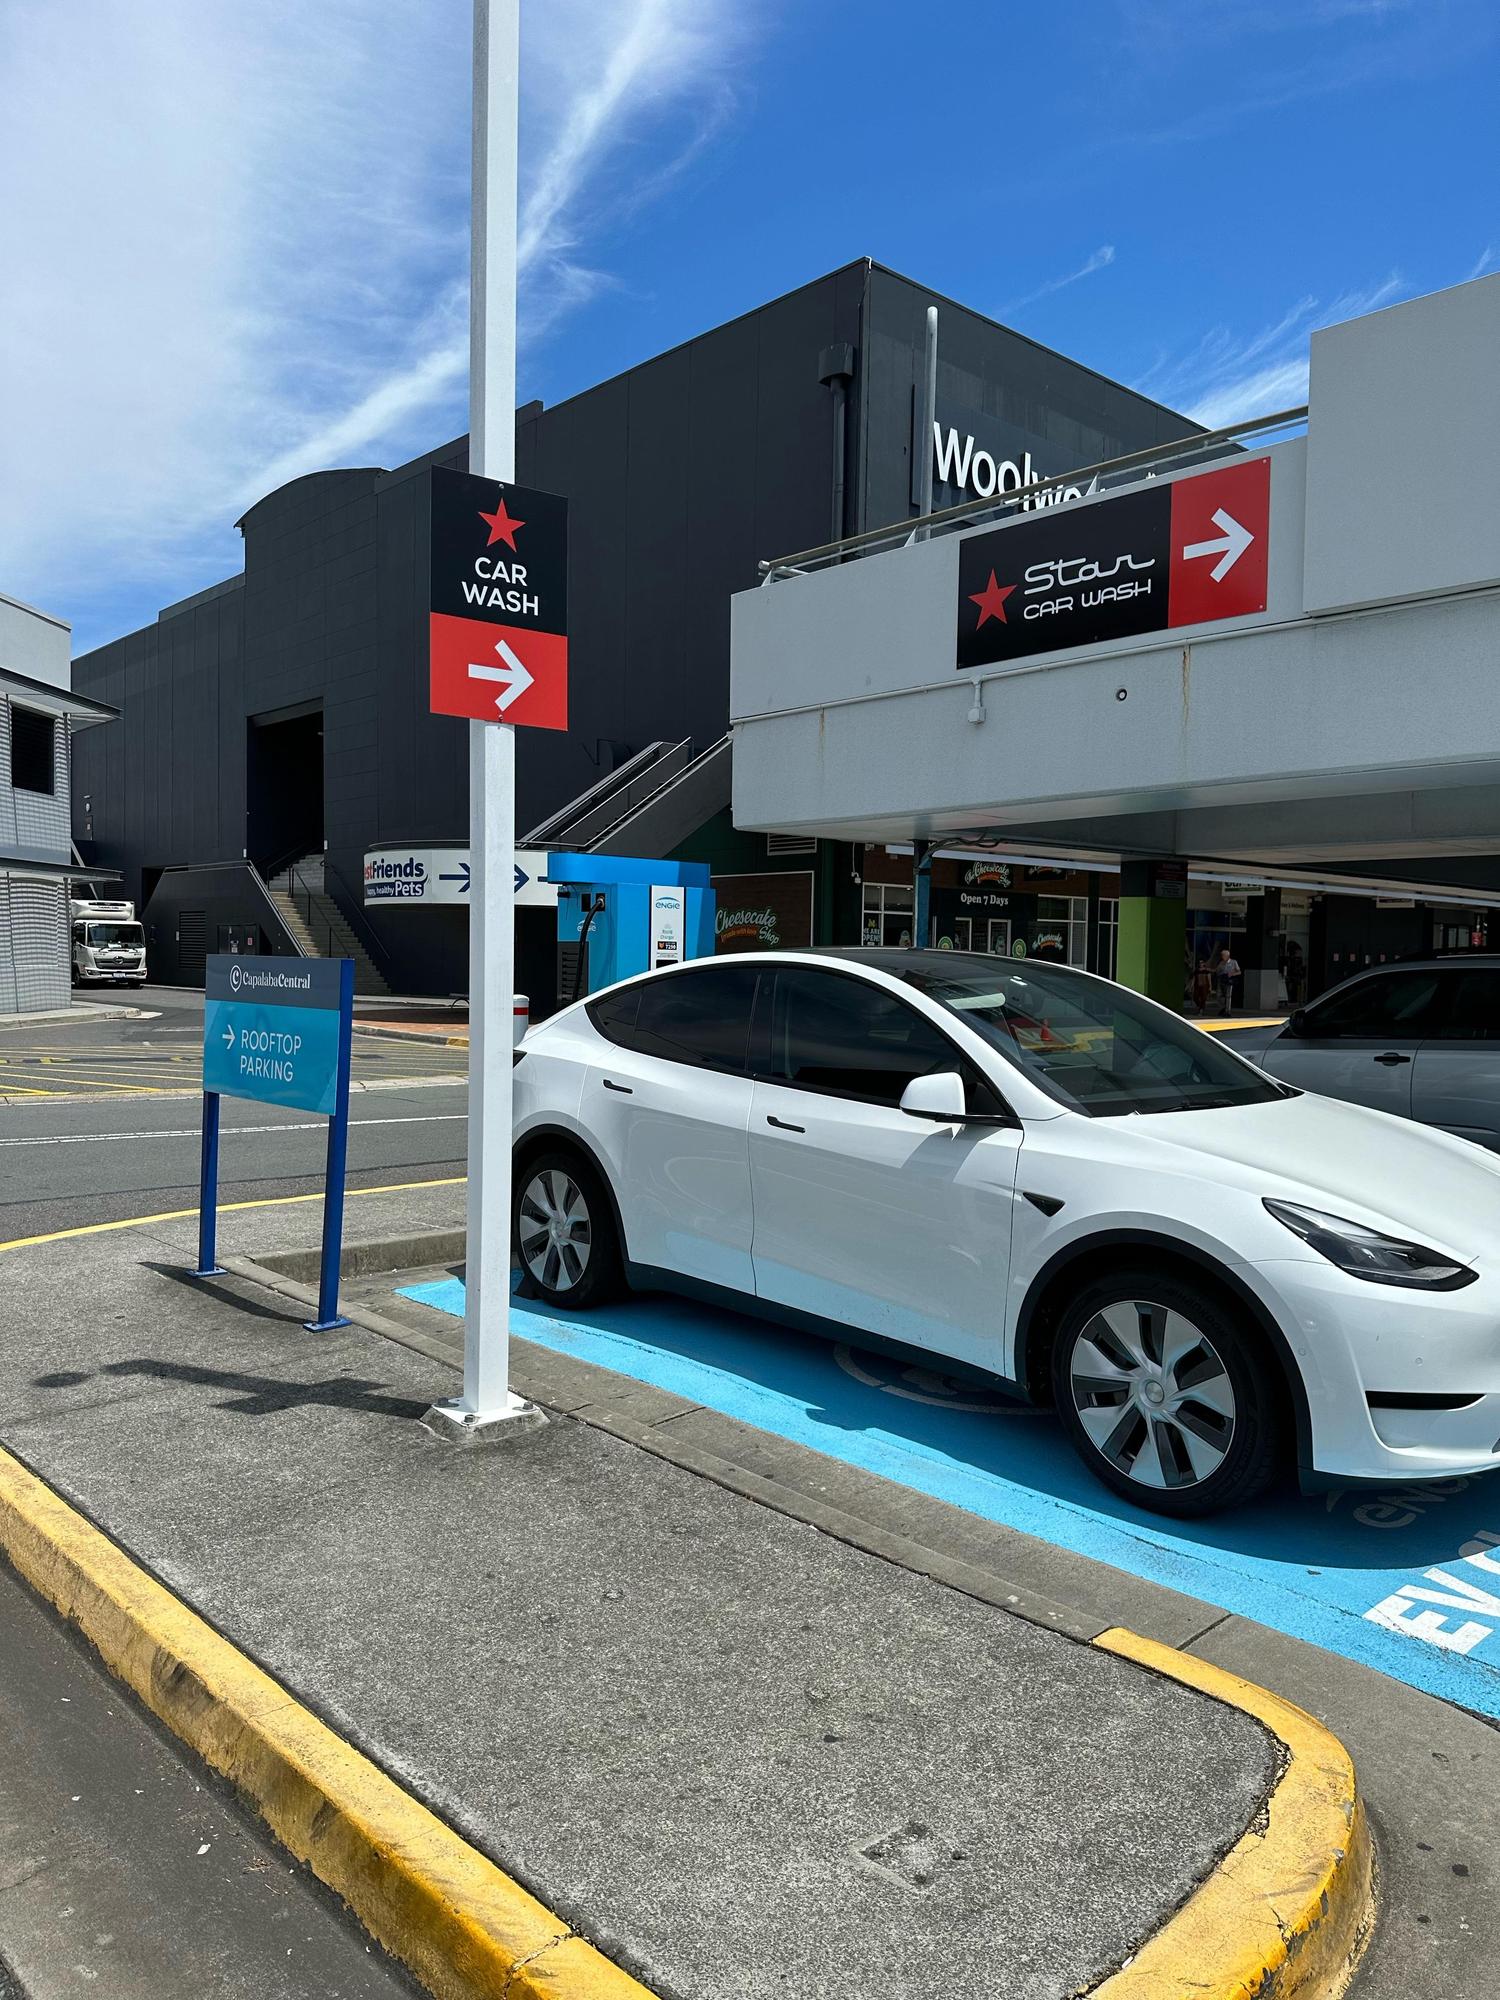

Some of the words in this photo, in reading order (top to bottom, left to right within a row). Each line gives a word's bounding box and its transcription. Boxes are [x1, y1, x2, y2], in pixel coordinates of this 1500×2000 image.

[474, 556, 528, 587] CAR
[1024, 552, 1156, 595] Star
[461, 581, 539, 616] WASH
[1023, 596, 1073, 621] CAR
[1081, 579, 1152, 608] WASH
[395, 881, 423, 897] Pets
[960, 893, 982, 905] Open
[983, 896, 988, 905] 7
[989, 895, 1009, 907] Days
[715, 909, 777, 934] Cheesecake
[759, 926, 781, 945] Shop
[242, 971, 311, 989] CapalabaCentral
[241, 1029, 302, 1056] ROOFTOP
[240, 1055, 294, 1082] PARKING
